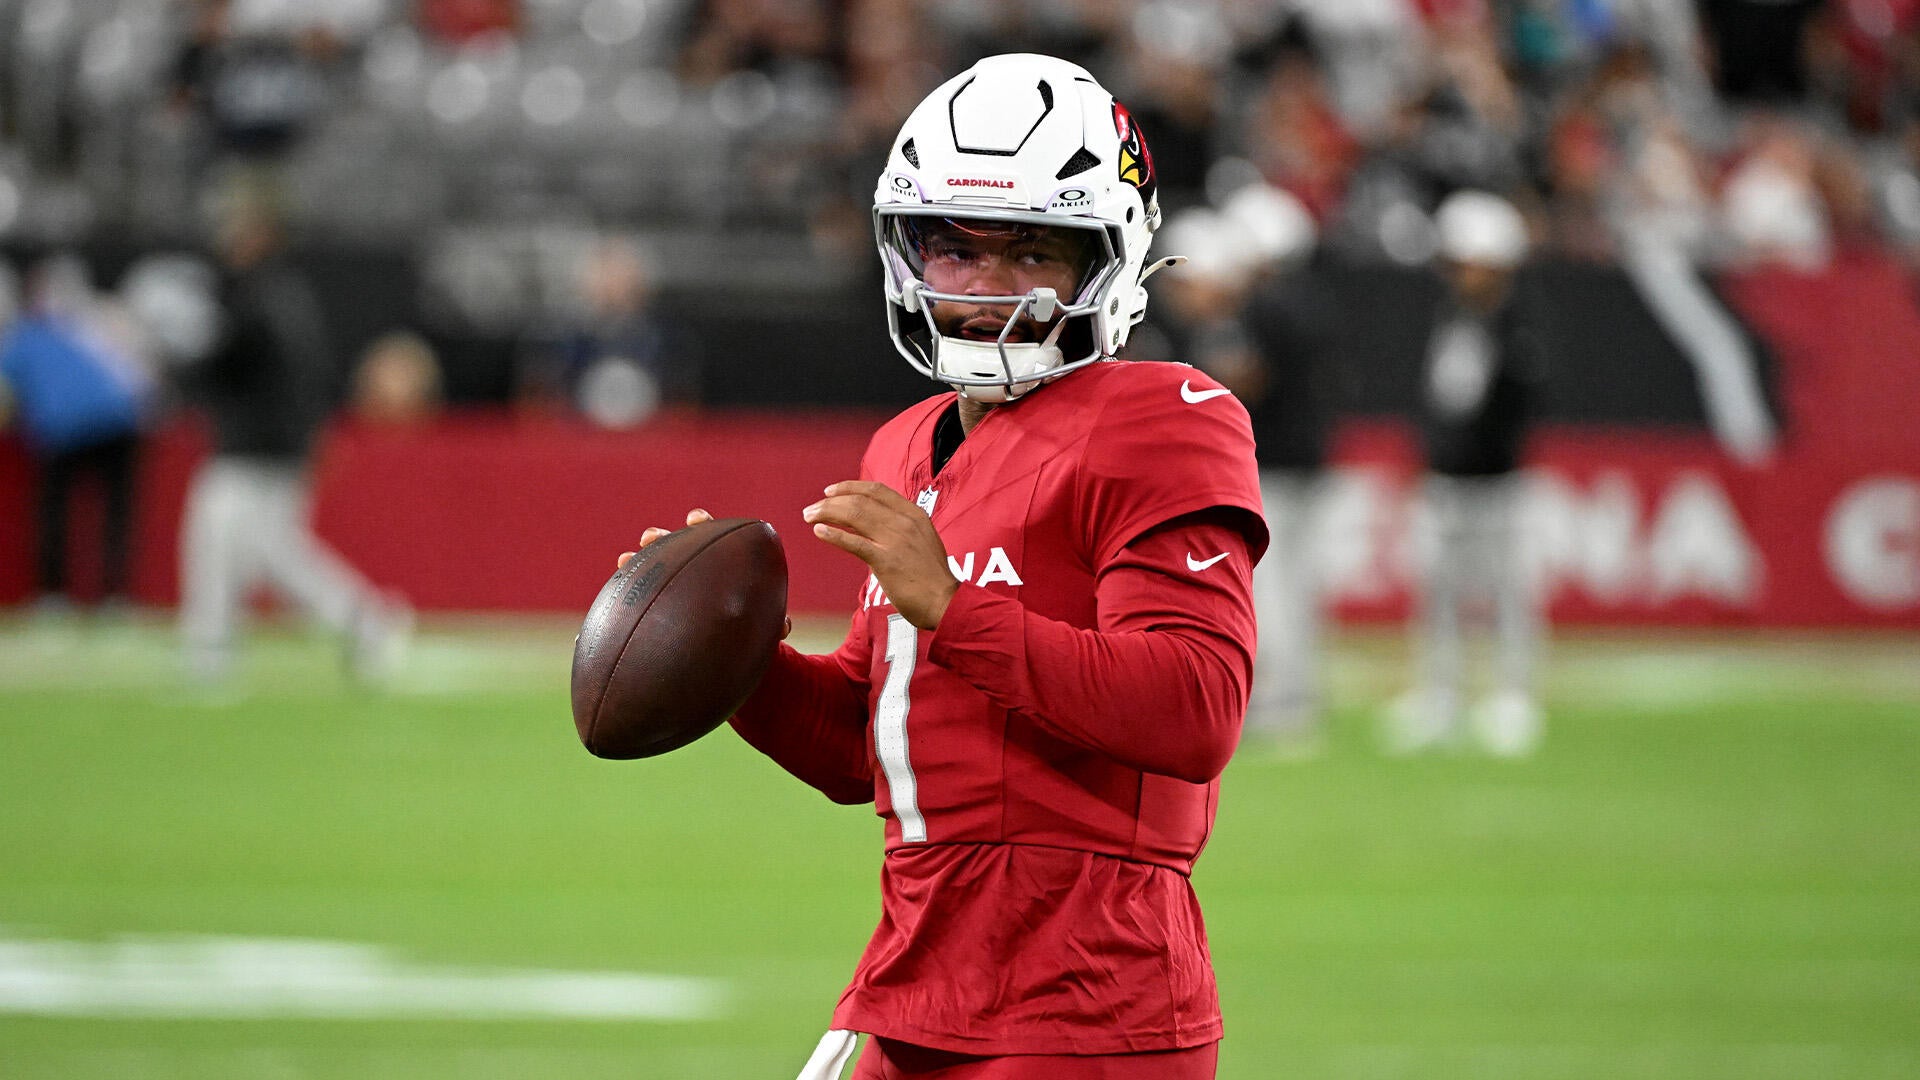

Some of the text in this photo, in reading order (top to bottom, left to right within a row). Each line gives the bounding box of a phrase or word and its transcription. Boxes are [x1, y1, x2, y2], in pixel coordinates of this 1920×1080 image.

[946, 178, 1015, 190] CARDINALS
[890, 186, 917, 198] OAKLEY
[1051, 200, 1092, 208] OAKLEY
[874, 613, 928, 843] 1
